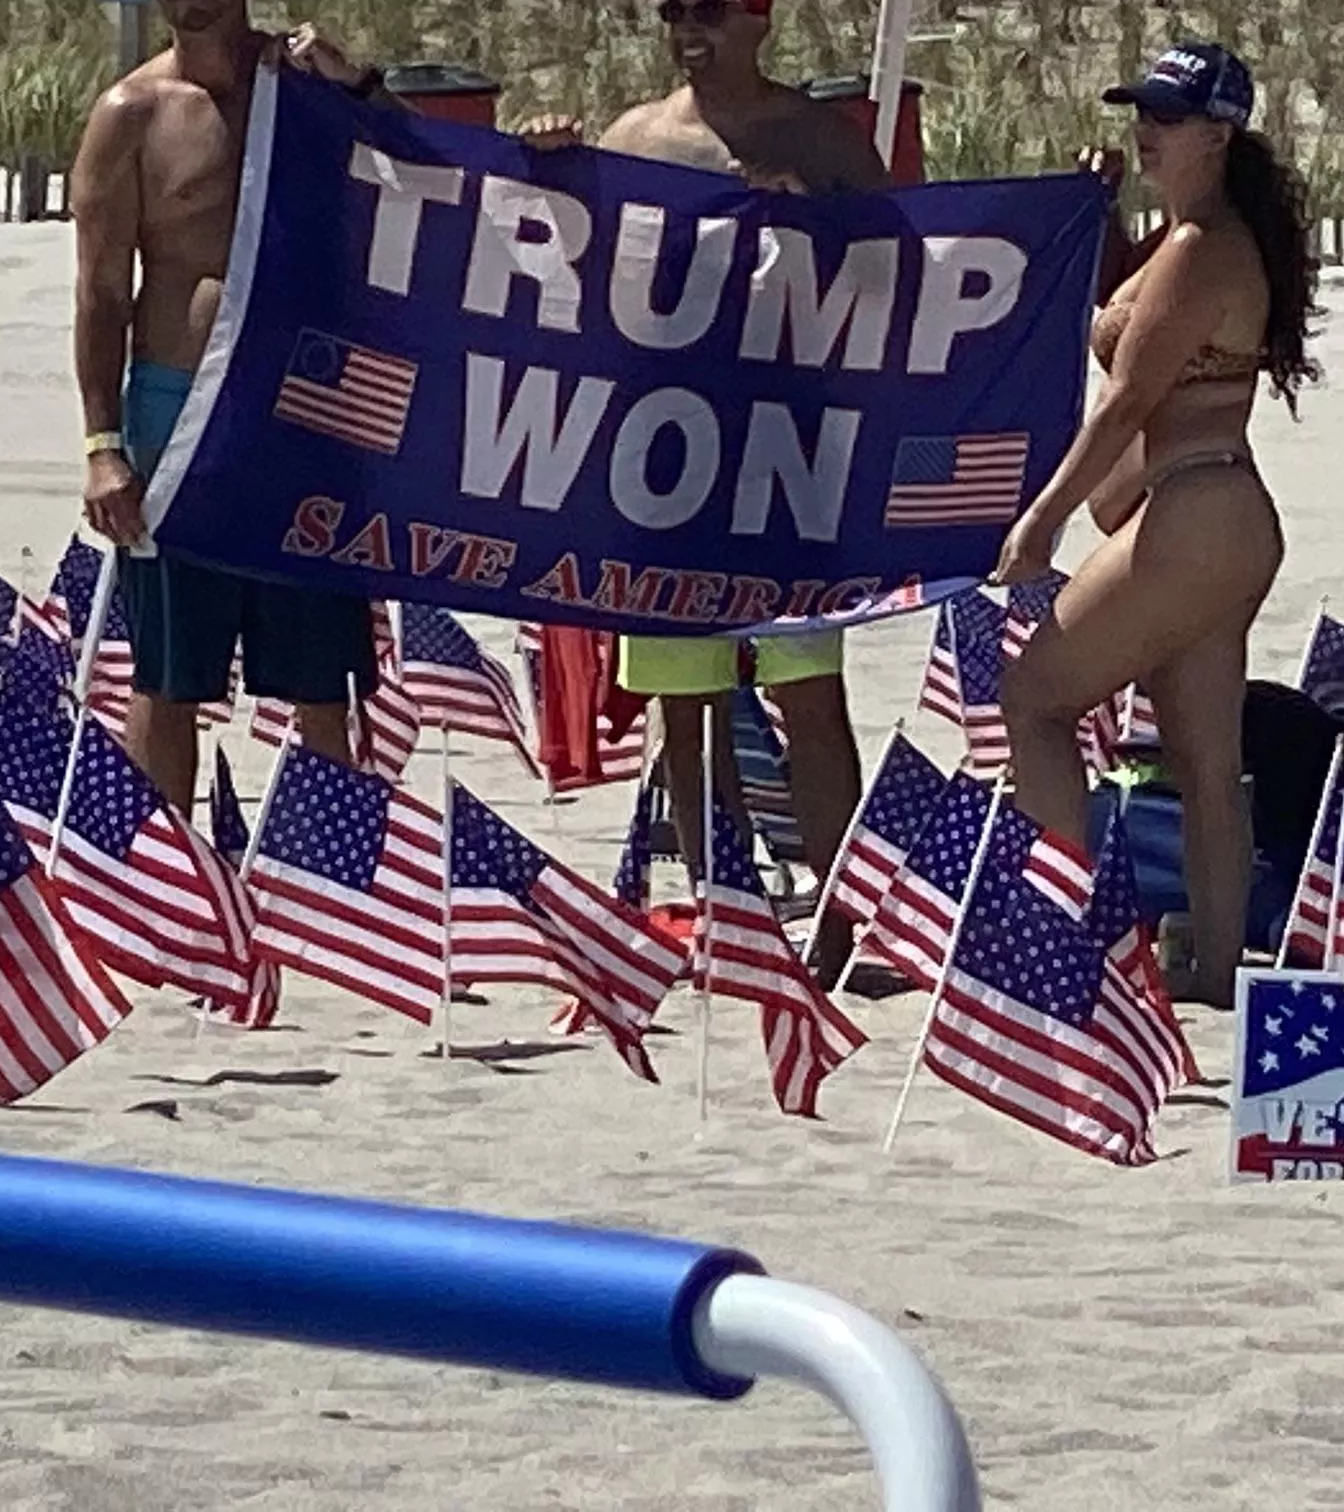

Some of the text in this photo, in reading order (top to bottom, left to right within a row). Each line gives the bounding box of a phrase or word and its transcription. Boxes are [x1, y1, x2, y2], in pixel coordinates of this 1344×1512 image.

[348, 140, 1029, 375] TRUMP
[282, 494, 518, 589] SAVE
[459, 350, 861, 543] WON
